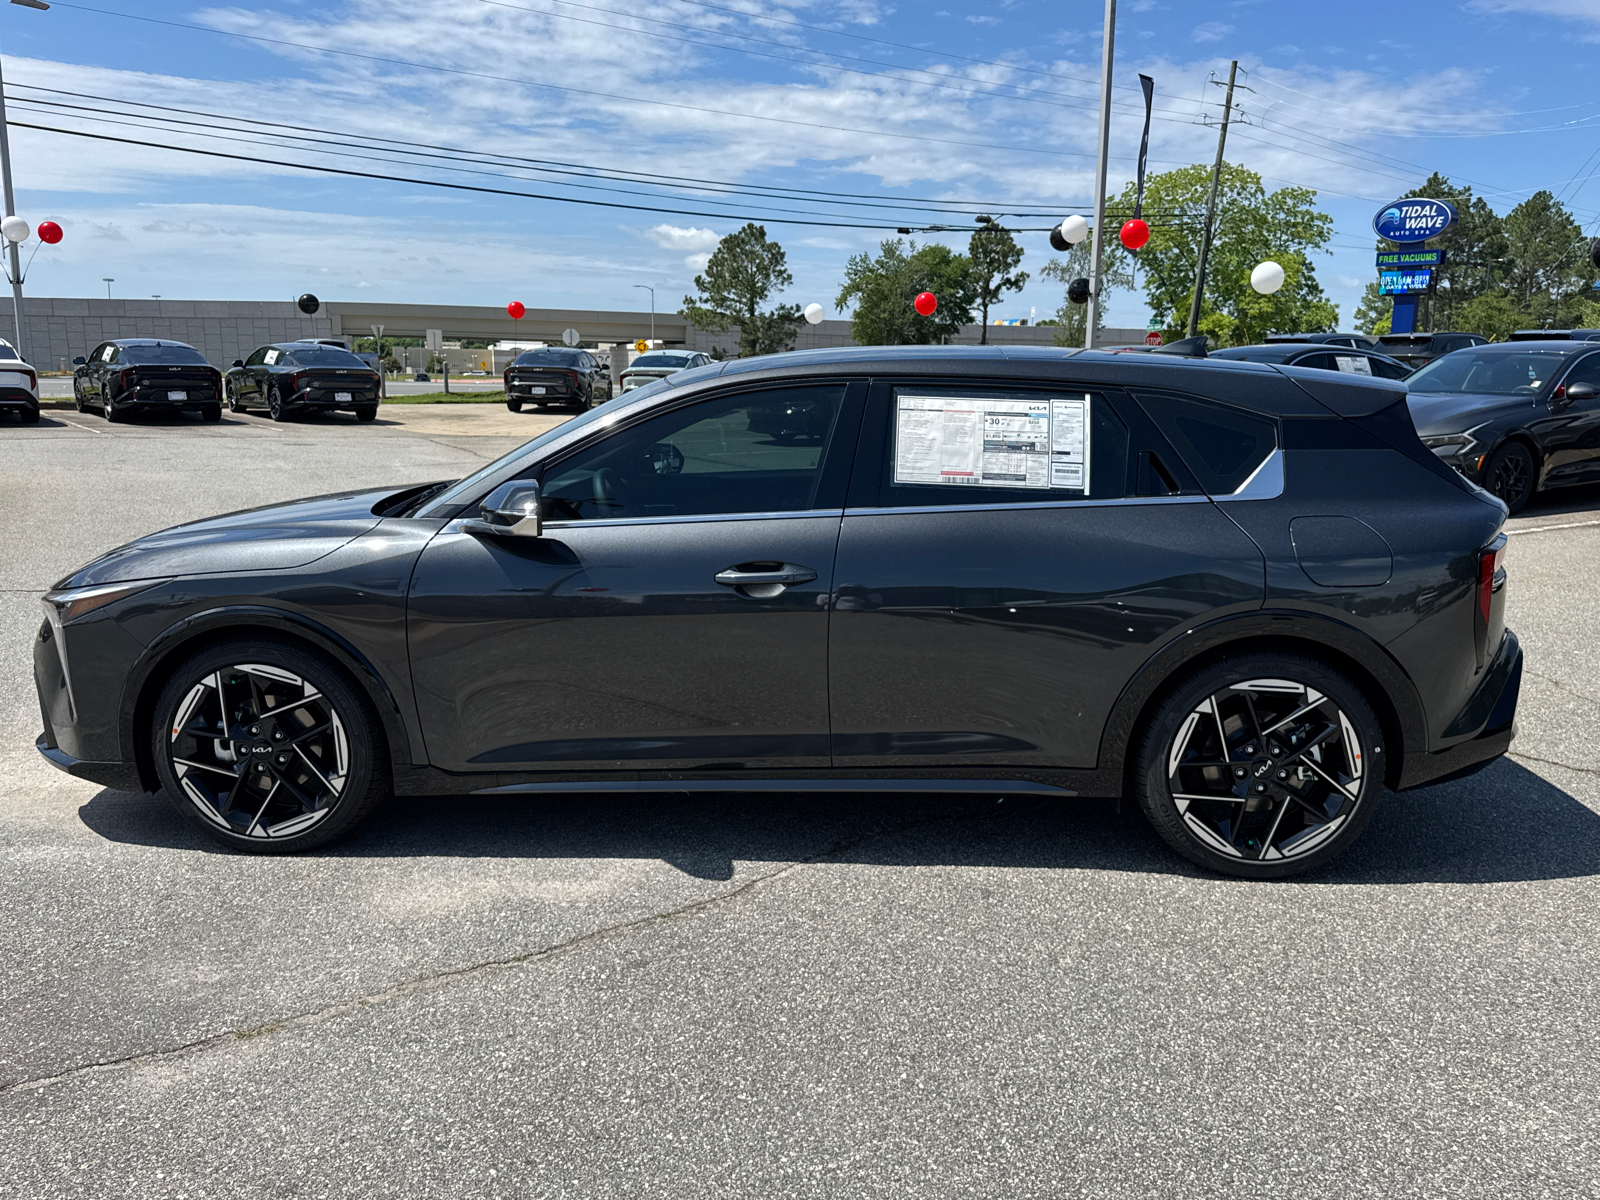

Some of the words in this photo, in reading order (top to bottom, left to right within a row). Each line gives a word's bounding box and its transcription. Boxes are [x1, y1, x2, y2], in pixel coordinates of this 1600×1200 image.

[1401, 205, 1437, 218] TIDAL
[1405, 216, 1444, 229] WAVE
[1379, 255, 1399, 264] FREE
[1400, 253, 1437, 262] VACUUMS
[1146, 337, 1161, 346] STOP
[989, 417, 1000, 425] 30
[1254, 759, 1272, 777] KIA
[1160, 803, 1198, 851] KUMHO
[262, 833, 319, 852] KUMHO
